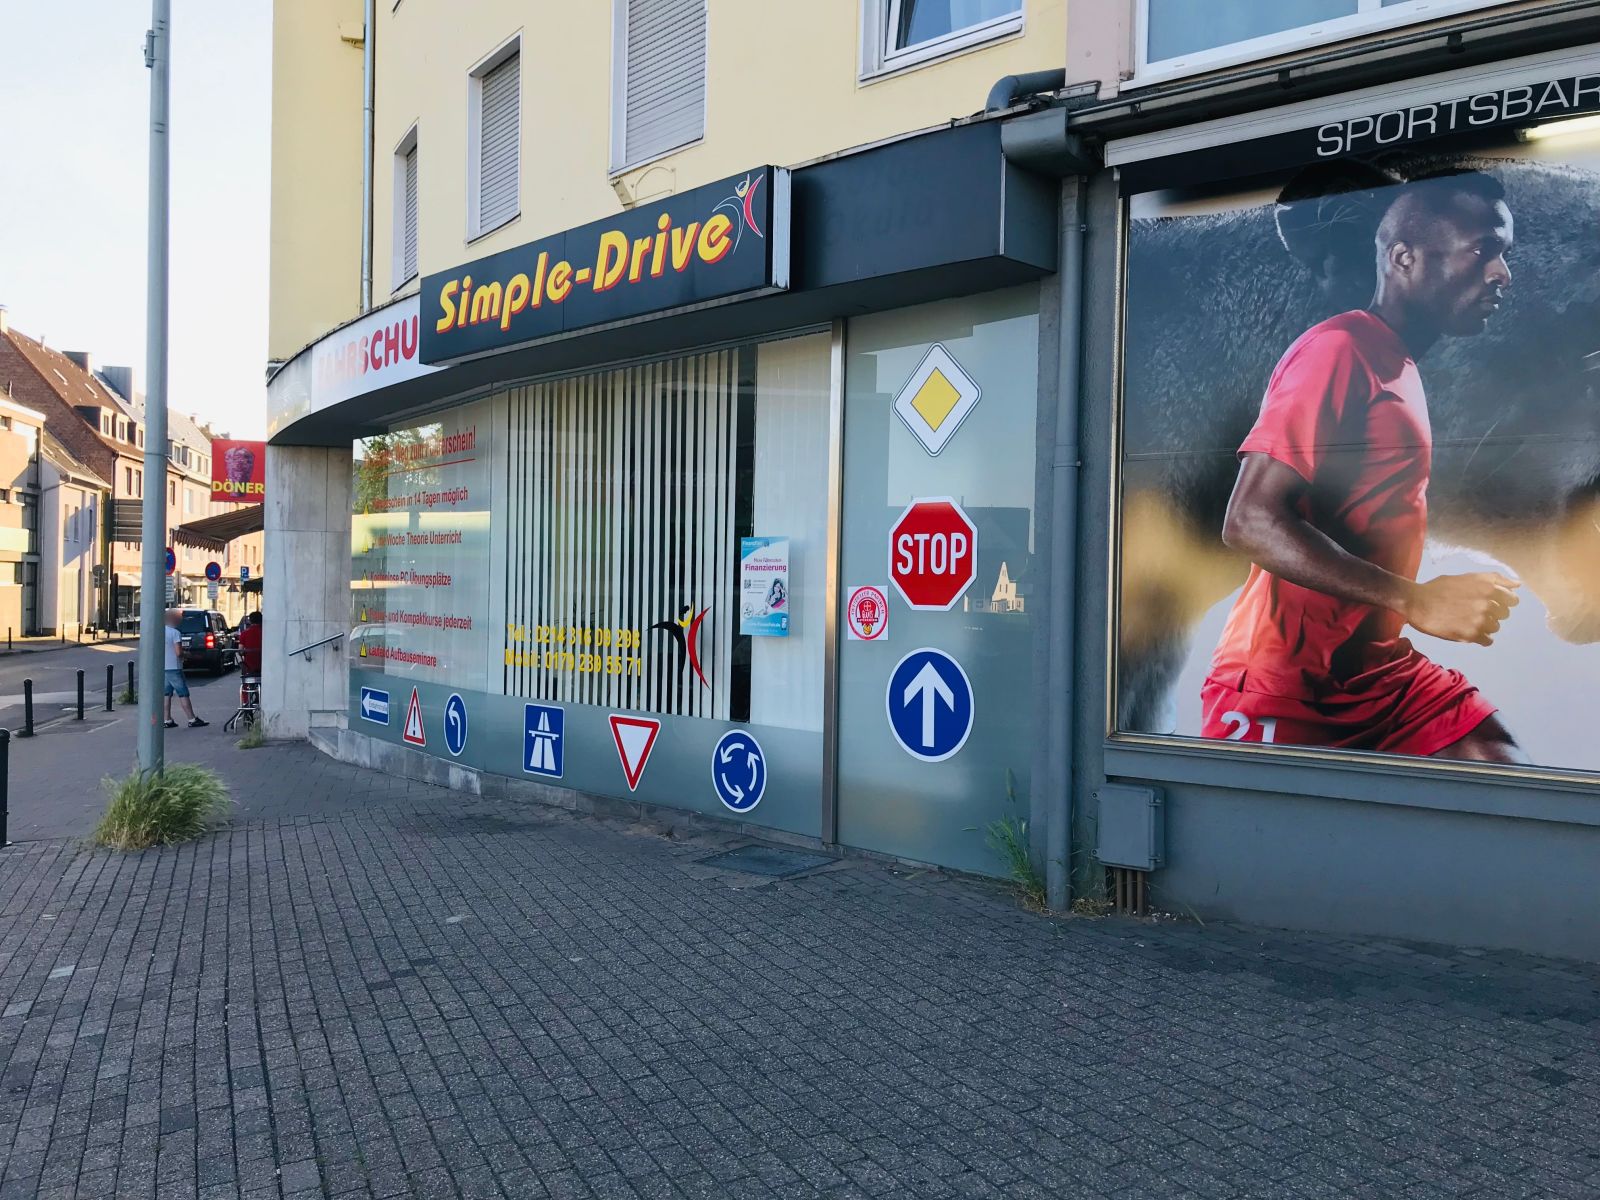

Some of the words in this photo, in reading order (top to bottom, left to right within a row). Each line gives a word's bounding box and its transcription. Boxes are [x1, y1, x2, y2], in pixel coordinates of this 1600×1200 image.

[1316, 73, 1600, 157] SPORTSBAR
[436, 212, 732, 332] Simple-Drive
[318, 314, 418, 388] AHRSCHU
[429, 425, 476, 458] erschein!
[212, 479, 264, 494] DÖNER
[414, 492, 420, 505] 14
[422, 491, 440, 507] Tagen
[441, 486, 468, 506] möglich
[407, 531, 428, 545] Theorie
[430, 530, 462, 545] Unterricht
[897, 532, 967, 575] STOP
[400, 571, 409, 584] PC
[410, 568, 452, 588] Übungsplätze
[745, 564, 787, 572] Finanzierung
[400, 610, 441, 627] Kompaktkurse
[443, 614, 472, 630] jederzeit
[536, 625, 565, 644] 0214
[569, 627, 591, 647] 316
[595, 628, 611, 648] 09
[615, 629, 640, 649] 298
[391, 647, 437, 667] Aufbauseminare
[545, 651, 574, 671] 0179
[606, 655, 622, 675] 55
[627, 657, 641, 677] 71
[1221, 711, 1277, 743] 21
